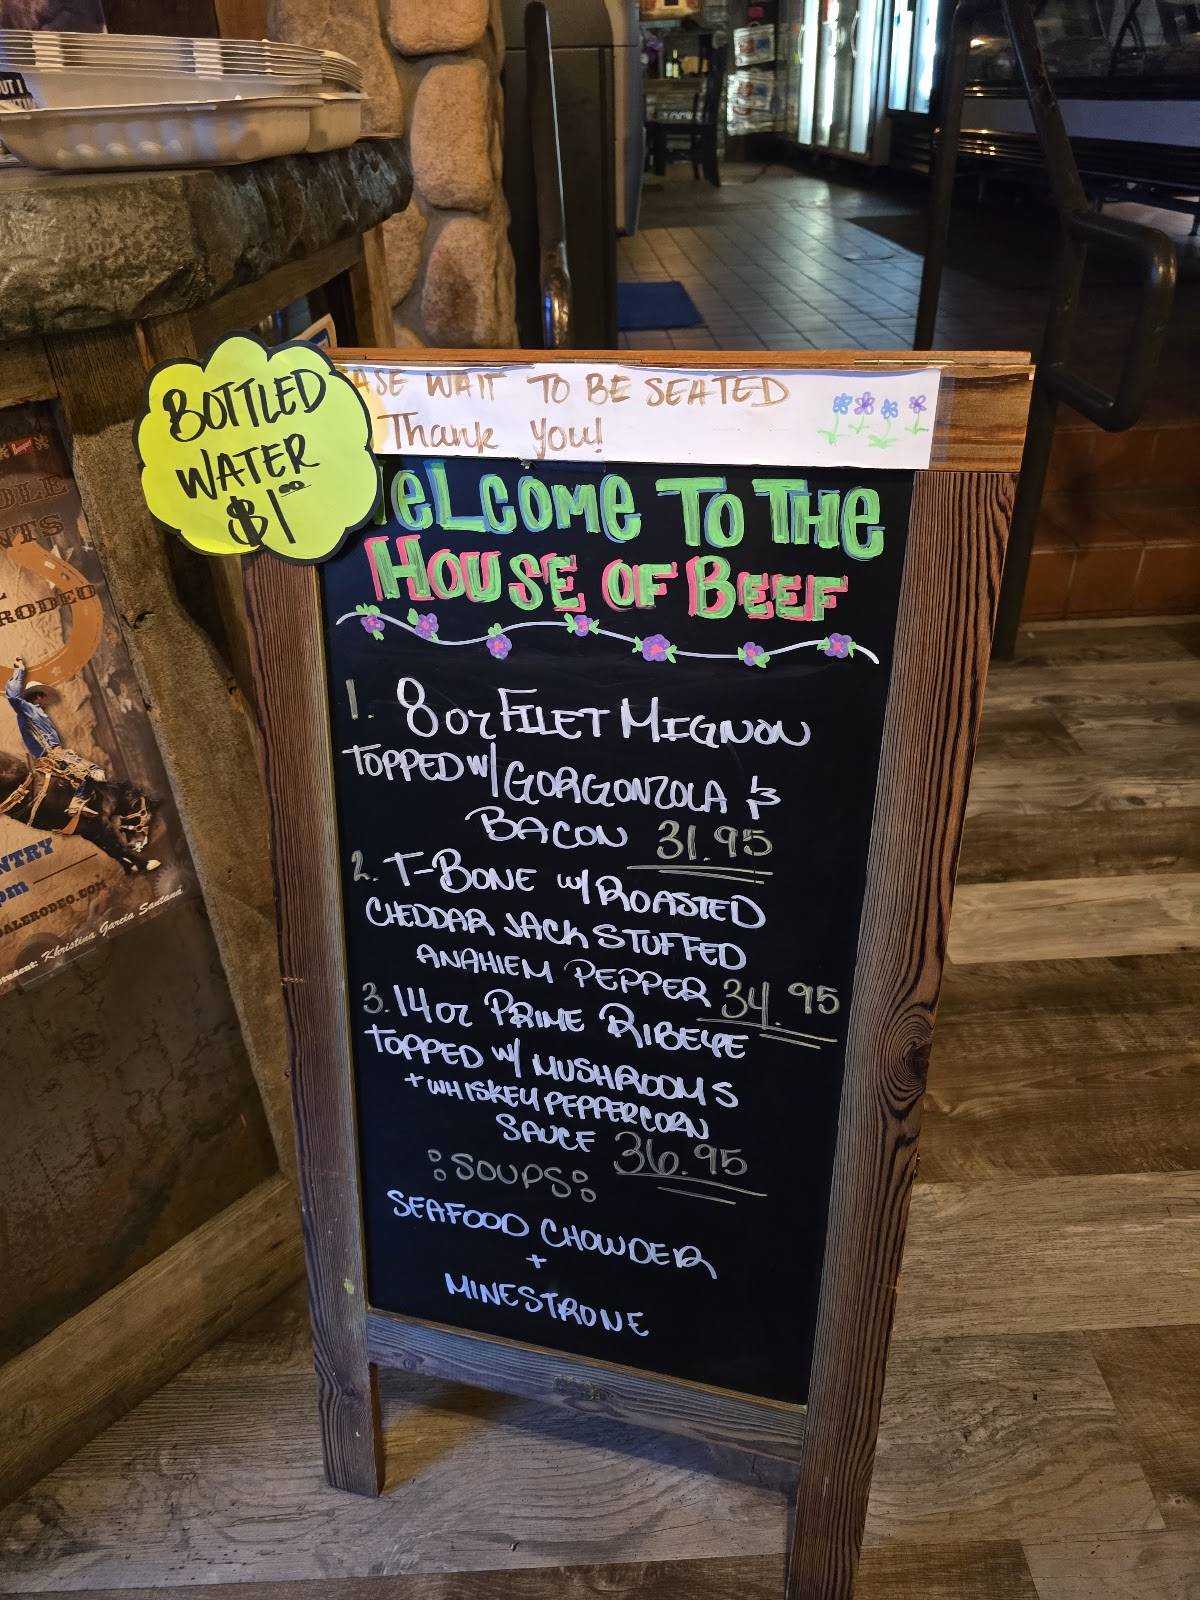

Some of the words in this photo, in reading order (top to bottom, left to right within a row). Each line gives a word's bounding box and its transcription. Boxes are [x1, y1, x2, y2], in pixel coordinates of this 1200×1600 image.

[162, 368, 327, 442] BOTTLED
[341, 368, 408, 397] ASE
[426, 371, 508, 401] WAIT
[527, 373, 571, 406] TO
[585, 373, 630, 406] BE
[645, 375, 791, 408] SEATED
[376, 411, 500, 454] Thank
[175, 433, 320, 501] WATER
[364, 534, 587, 613] HOUSE
[601, 558, 679, 611] OF
[686, 555, 849, 622] BEEF
[498, 688, 611, 740] FILET
[620, 697, 812, 749] MIGNON
[342, 743, 465, 782] TOPPED
[503, 760, 728, 814] GORGONZOLA
[464, 805, 629, 849] BACON
[656, 819, 774, 862] 31.95
[383, 847, 538, 894] T-BONE
[594, 874, 767, 929] ROASTED
[99, 912, 136, 937] Garcia
[365, 896, 496, 937] CHEDDAR
[503, 911, 590, 949] JACK
[592, 923, 747, 971] STUFFED
[416, 943, 554, 984] ANAHIEM
[563, 957, 712, 1009] PEPPER
[483, 988, 585, 1032] PRIME
[598, 1001, 750, 1059] RIBEYE
[427, 1078, 540, 1112] WHISKEY
[544, 1090, 710, 1140] PEPPERCORN
[532, 1053, 740, 1109] MUSHROOMS
[495, 1113, 597, 1153] SAUCE
[613, 1131, 748, 1177] 36.95
[386, 1188, 530, 1238] SEAFOOD
[540, 1217, 719, 1280] CHOWDER
[443, 1272, 650, 1338] MINESTRONE
